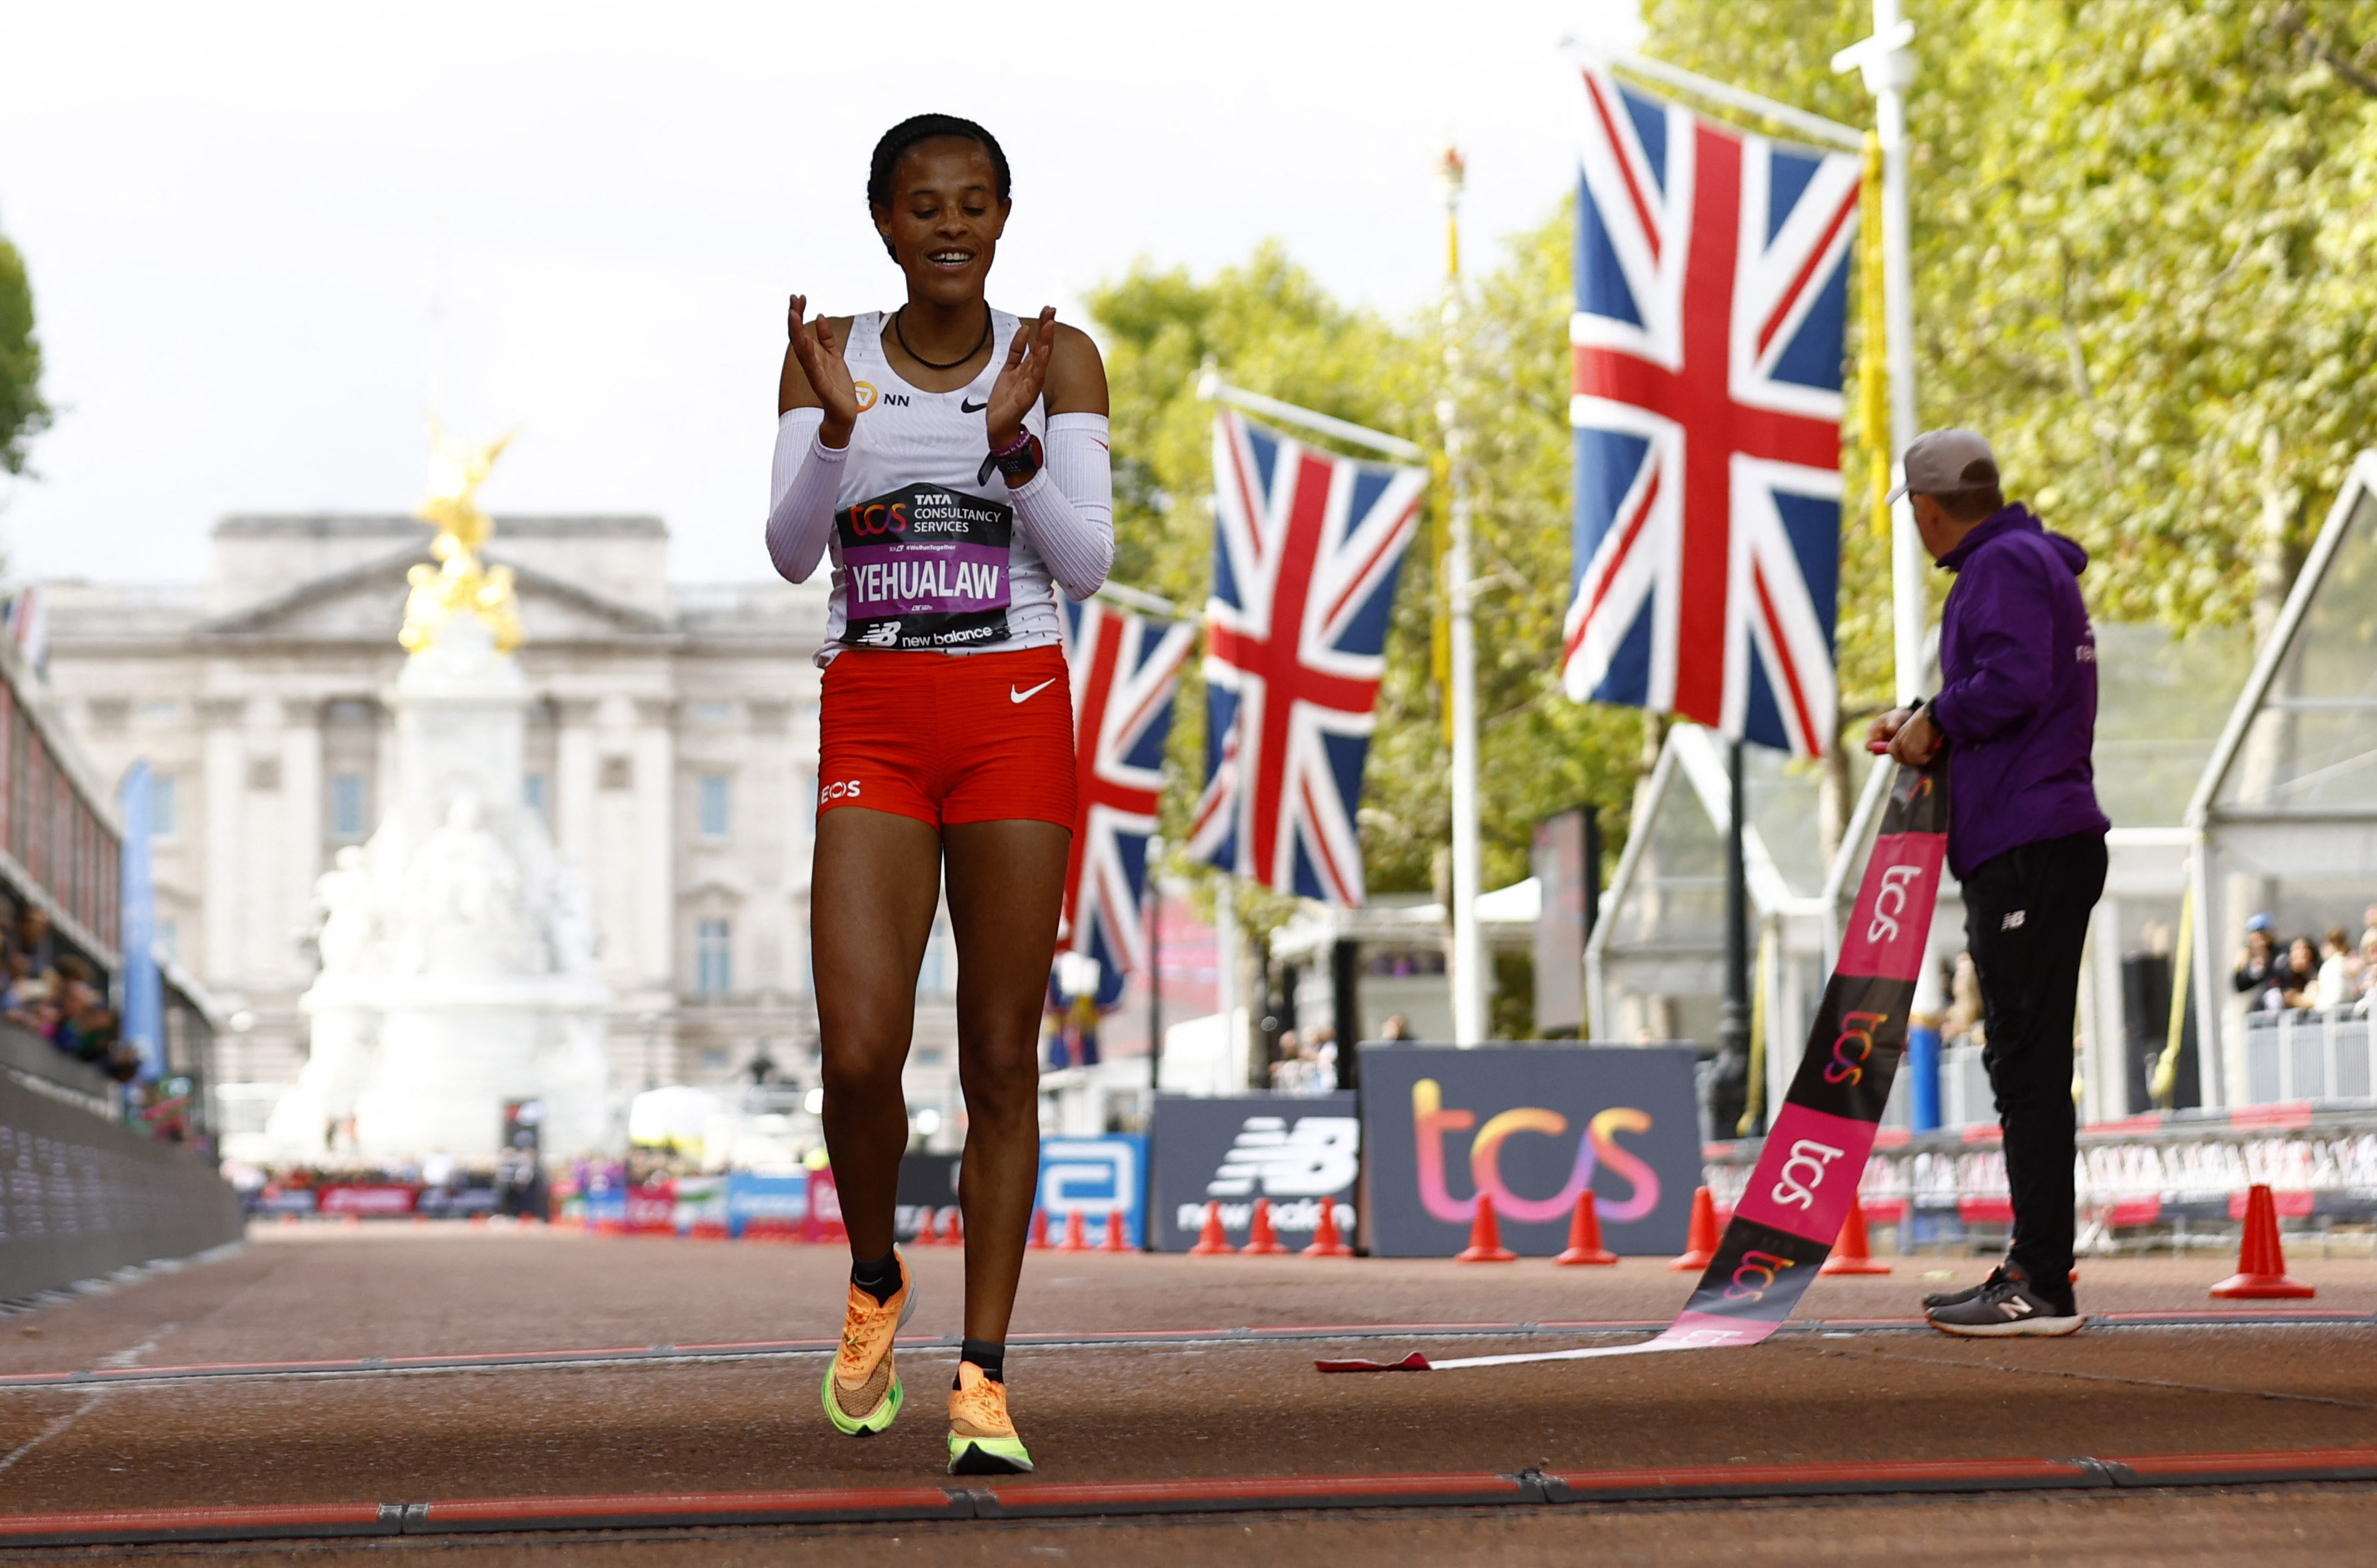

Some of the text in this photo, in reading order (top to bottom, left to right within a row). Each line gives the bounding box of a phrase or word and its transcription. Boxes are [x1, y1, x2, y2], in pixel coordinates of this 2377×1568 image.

[884, 393, 909, 407] NN
[914, 508, 1001, 522] CONSULTANCY
[915, 494, 952, 505] TATA
[851, 503, 907, 536] tcs
[914, 521, 969, 532] SERVICES
[853, 560, 999, 603] YEHUALAW
[902, 636, 931, 647] new
[933, 626, 993, 645] balance
[819, 780, 861, 806] EOS
[1868, 864, 1923, 944] tcs
[1824, 1010, 1888, 1087] tcs
[1412, 1078, 1662, 1223] tcs
[1771, 1139, 1845, 1211] tcs
[1723, 1249, 1796, 1303] tcs
